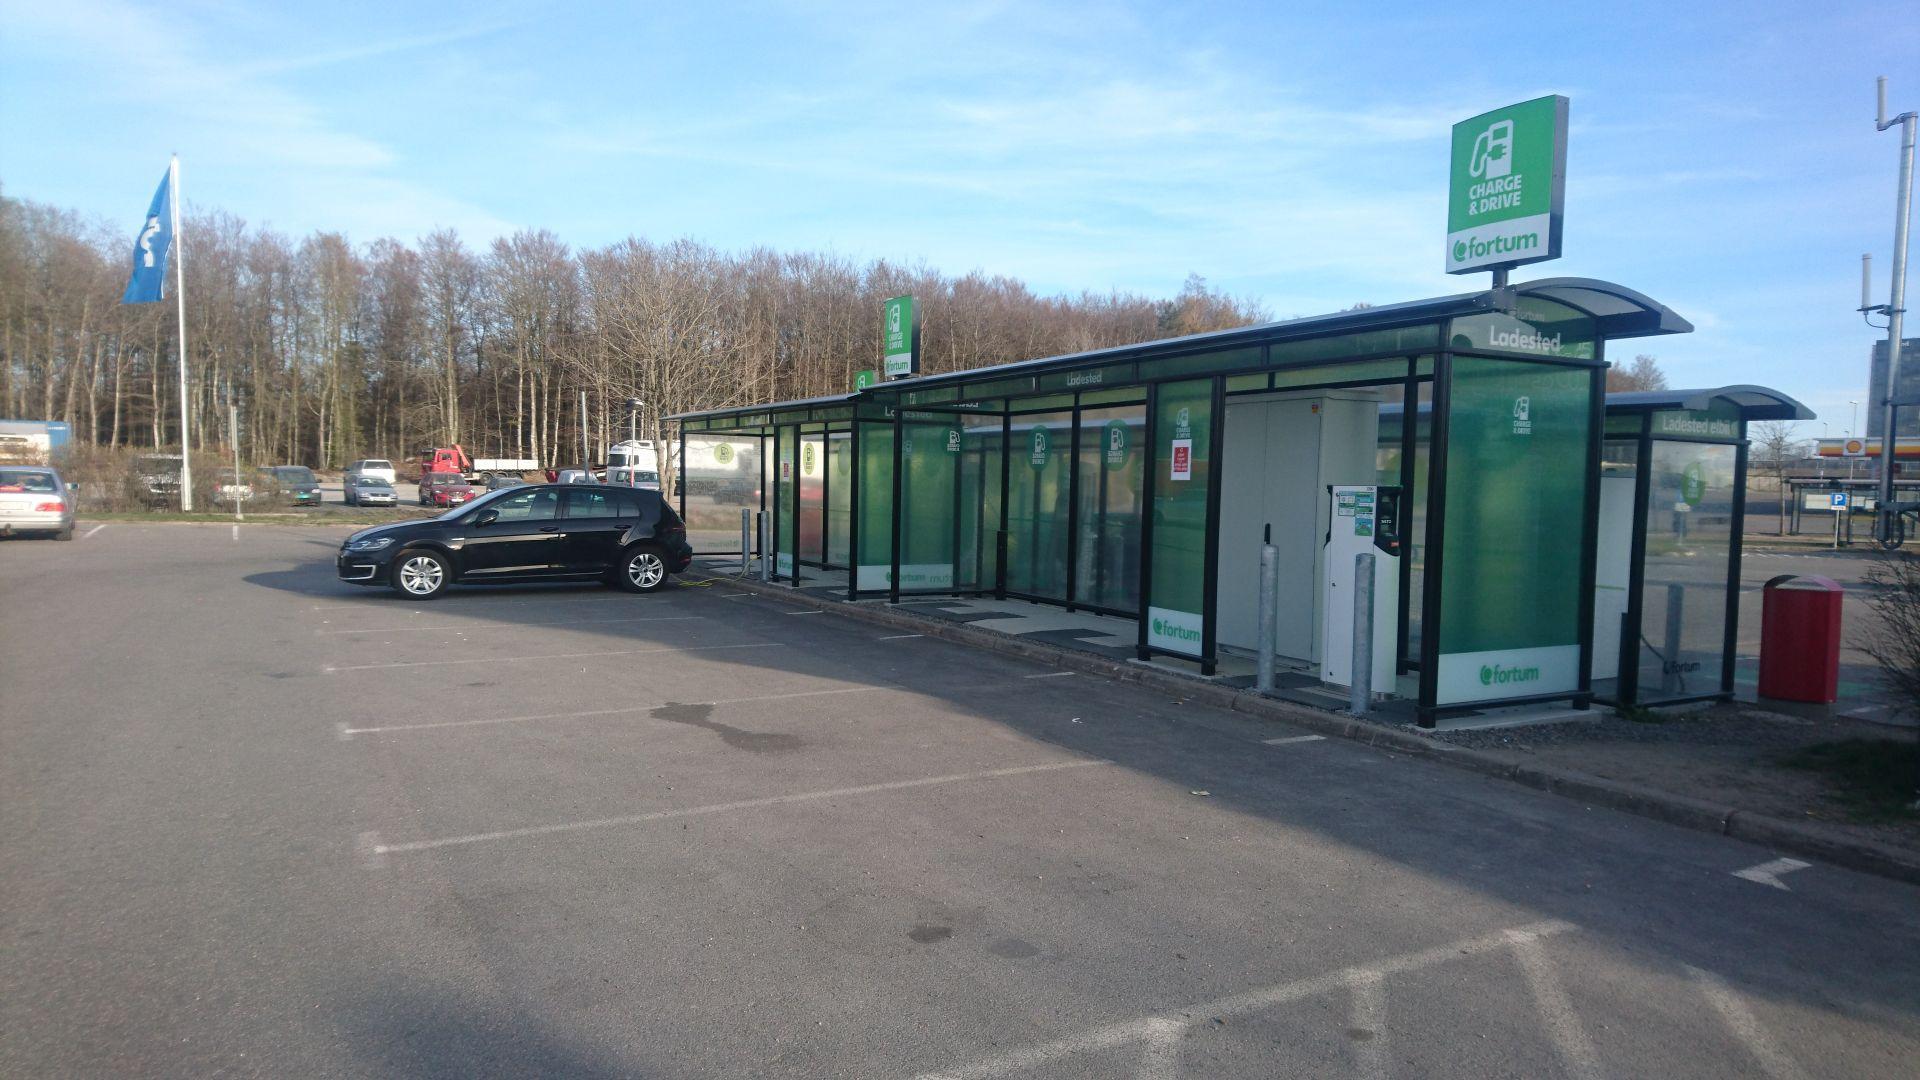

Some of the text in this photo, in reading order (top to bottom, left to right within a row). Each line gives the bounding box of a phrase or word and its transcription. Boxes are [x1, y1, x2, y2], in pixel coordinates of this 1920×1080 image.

[1469, 174, 1522, 200] CHARGE
[1468, 191, 1521, 215] & DRIVE
[1469, 232, 1538, 259] fortum
[1489, 325, 1560, 352] Ladested
[1663, 415, 1708, 433] Ladested
[1834, 495, 1843, 504] P
[1163, 619, 1200, 642] fortum
[1493, 664, 1540, 684] fortum
